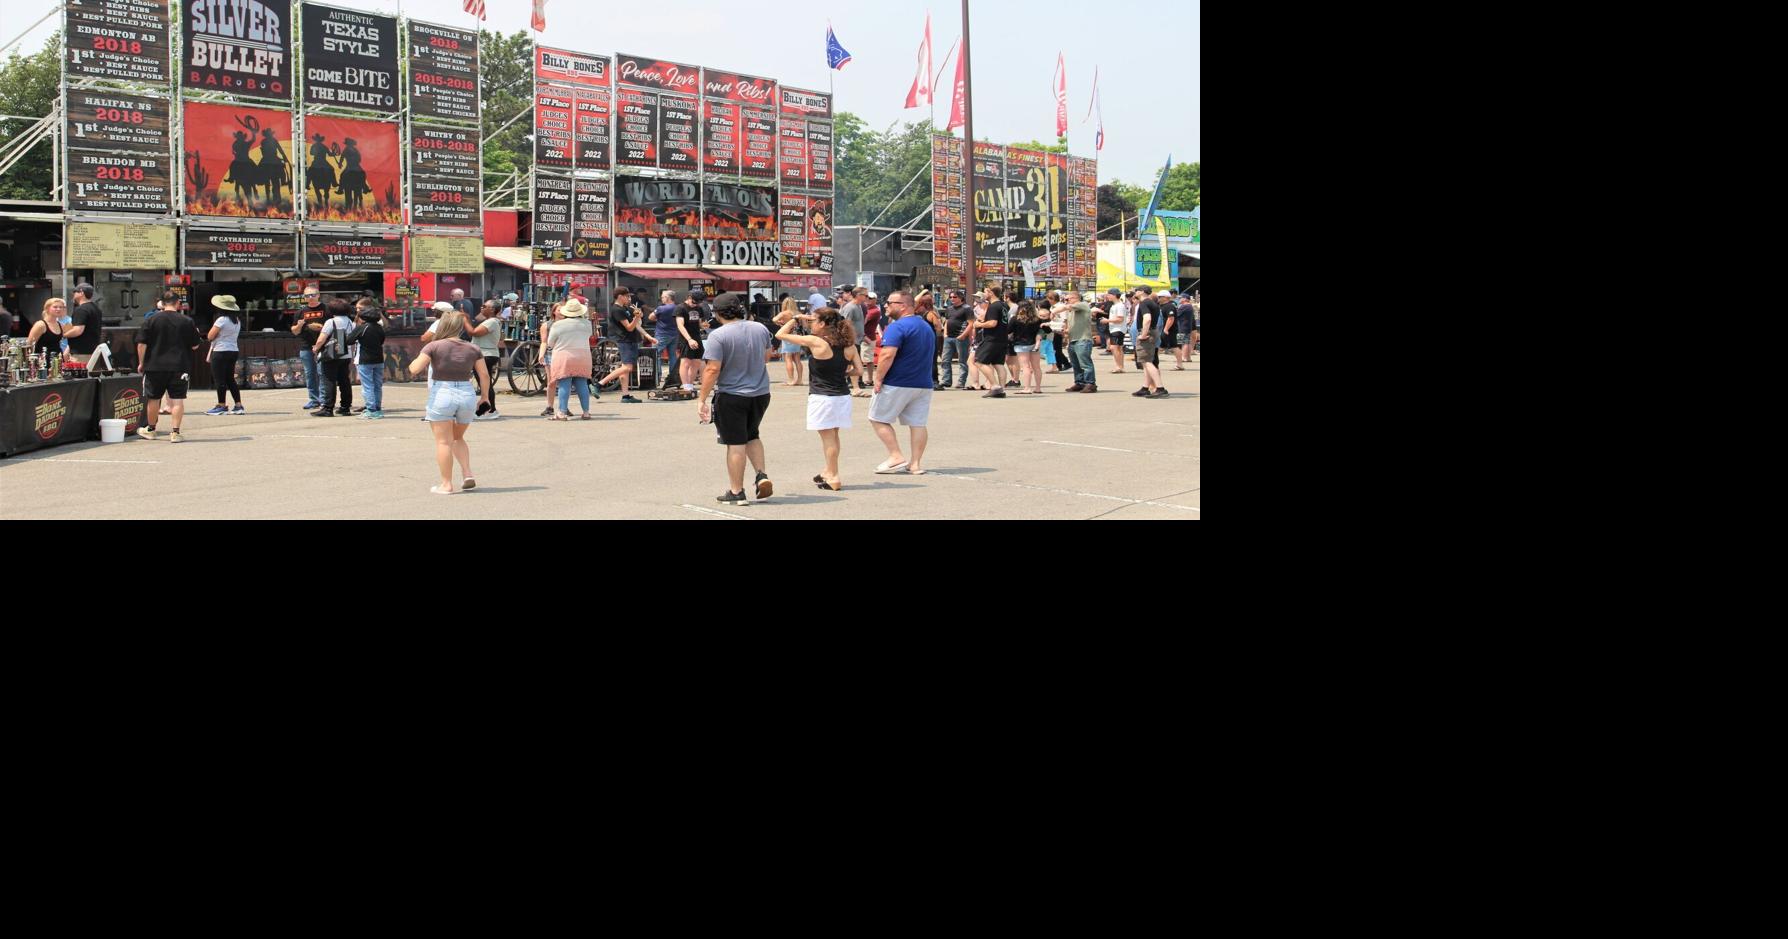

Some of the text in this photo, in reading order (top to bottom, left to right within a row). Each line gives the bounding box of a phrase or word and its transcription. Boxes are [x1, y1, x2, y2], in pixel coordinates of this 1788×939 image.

[106, 2, 128, 10] BEST
[130, 4, 150, 13] RIBS
[82, 13, 163, 30] BEST PULLED PORK
[106, 8, 159, 22] BEST SAUCE
[329, 11, 374, 25] AUTHENTIC
[191, 0, 282, 44] SILVER
[77, 25, 156, 42] EDMONTON AB
[322, 20, 379, 41] TEXAS
[414, 25, 460, 39] BROCKVILLE
[94, 36, 142, 54] 2018
[324, 37, 380, 58] STYLE
[430, 37, 459, 50] 2018
[72, 49, 95, 64] 1st
[132, 56, 160, 64] Choice
[413, 45, 430, 57] 1st
[191, 40, 283, 76] BULLET
[542, 54, 603, 74] BILLY BONES
[83, 66, 105, 74] BEST
[107, 68, 139, 78] PULLED
[106, 61, 158, 72] BEST SAUCE
[308, 67, 390, 90] COME BITE
[415, 73, 474, 90] 2015-2018
[621, 60, 772, 100] Peace, Love and Ribs!
[310, 86, 383, 105] THE BULLET
[414, 85, 430, 96] 1st
[85, 97, 152, 111] HALIFAX NS
[540, 97, 570, 108] 1ST Place
[783, 92, 827, 108] BILLY BONES
[579, 103, 607, 113] 1ST Place
[634, 106, 651, 115] Place
[96, 108, 144, 124] 2018
[677, 112, 692, 120] Place
[75, 122, 98, 138] 1st
[136, 128, 162, 136] Choice
[424, 130, 453, 138] WHITBY
[110, 134, 160, 144] BEST SAUCE
[415, 138, 476, 152] 2016-2018
[416, 152, 432, 163] 1st
[546, 150, 564, 158] 2022
[584, 150, 602, 158] 2022
[628, 150, 645, 158] 2022
[82, 156, 156, 168] BRANDON MB
[96, 166, 145, 181] 2018
[76, 182, 99, 197] 1st
[416, 182, 462, 192] BURLINGTON
[133, 193, 161, 201] SAUCE
[430, 192, 462, 203] 2018
[550, 192, 569, 200] Place
[578, 194, 606, 203] 1ST Place
[625, 182, 773, 216] WORLD FAMOUS
[1026, 166, 1062, 232] 31
[415, 204, 433, 216] 2nd
[974, 186, 1025, 223] CAMP
[1051, 233, 1066, 244] RIBS
[210, 251, 226, 263] 1st
[360, 246, 385, 255] 2018
[626, 236, 780, 266] BILLY BONES
[328, 254, 342, 265] 1st
